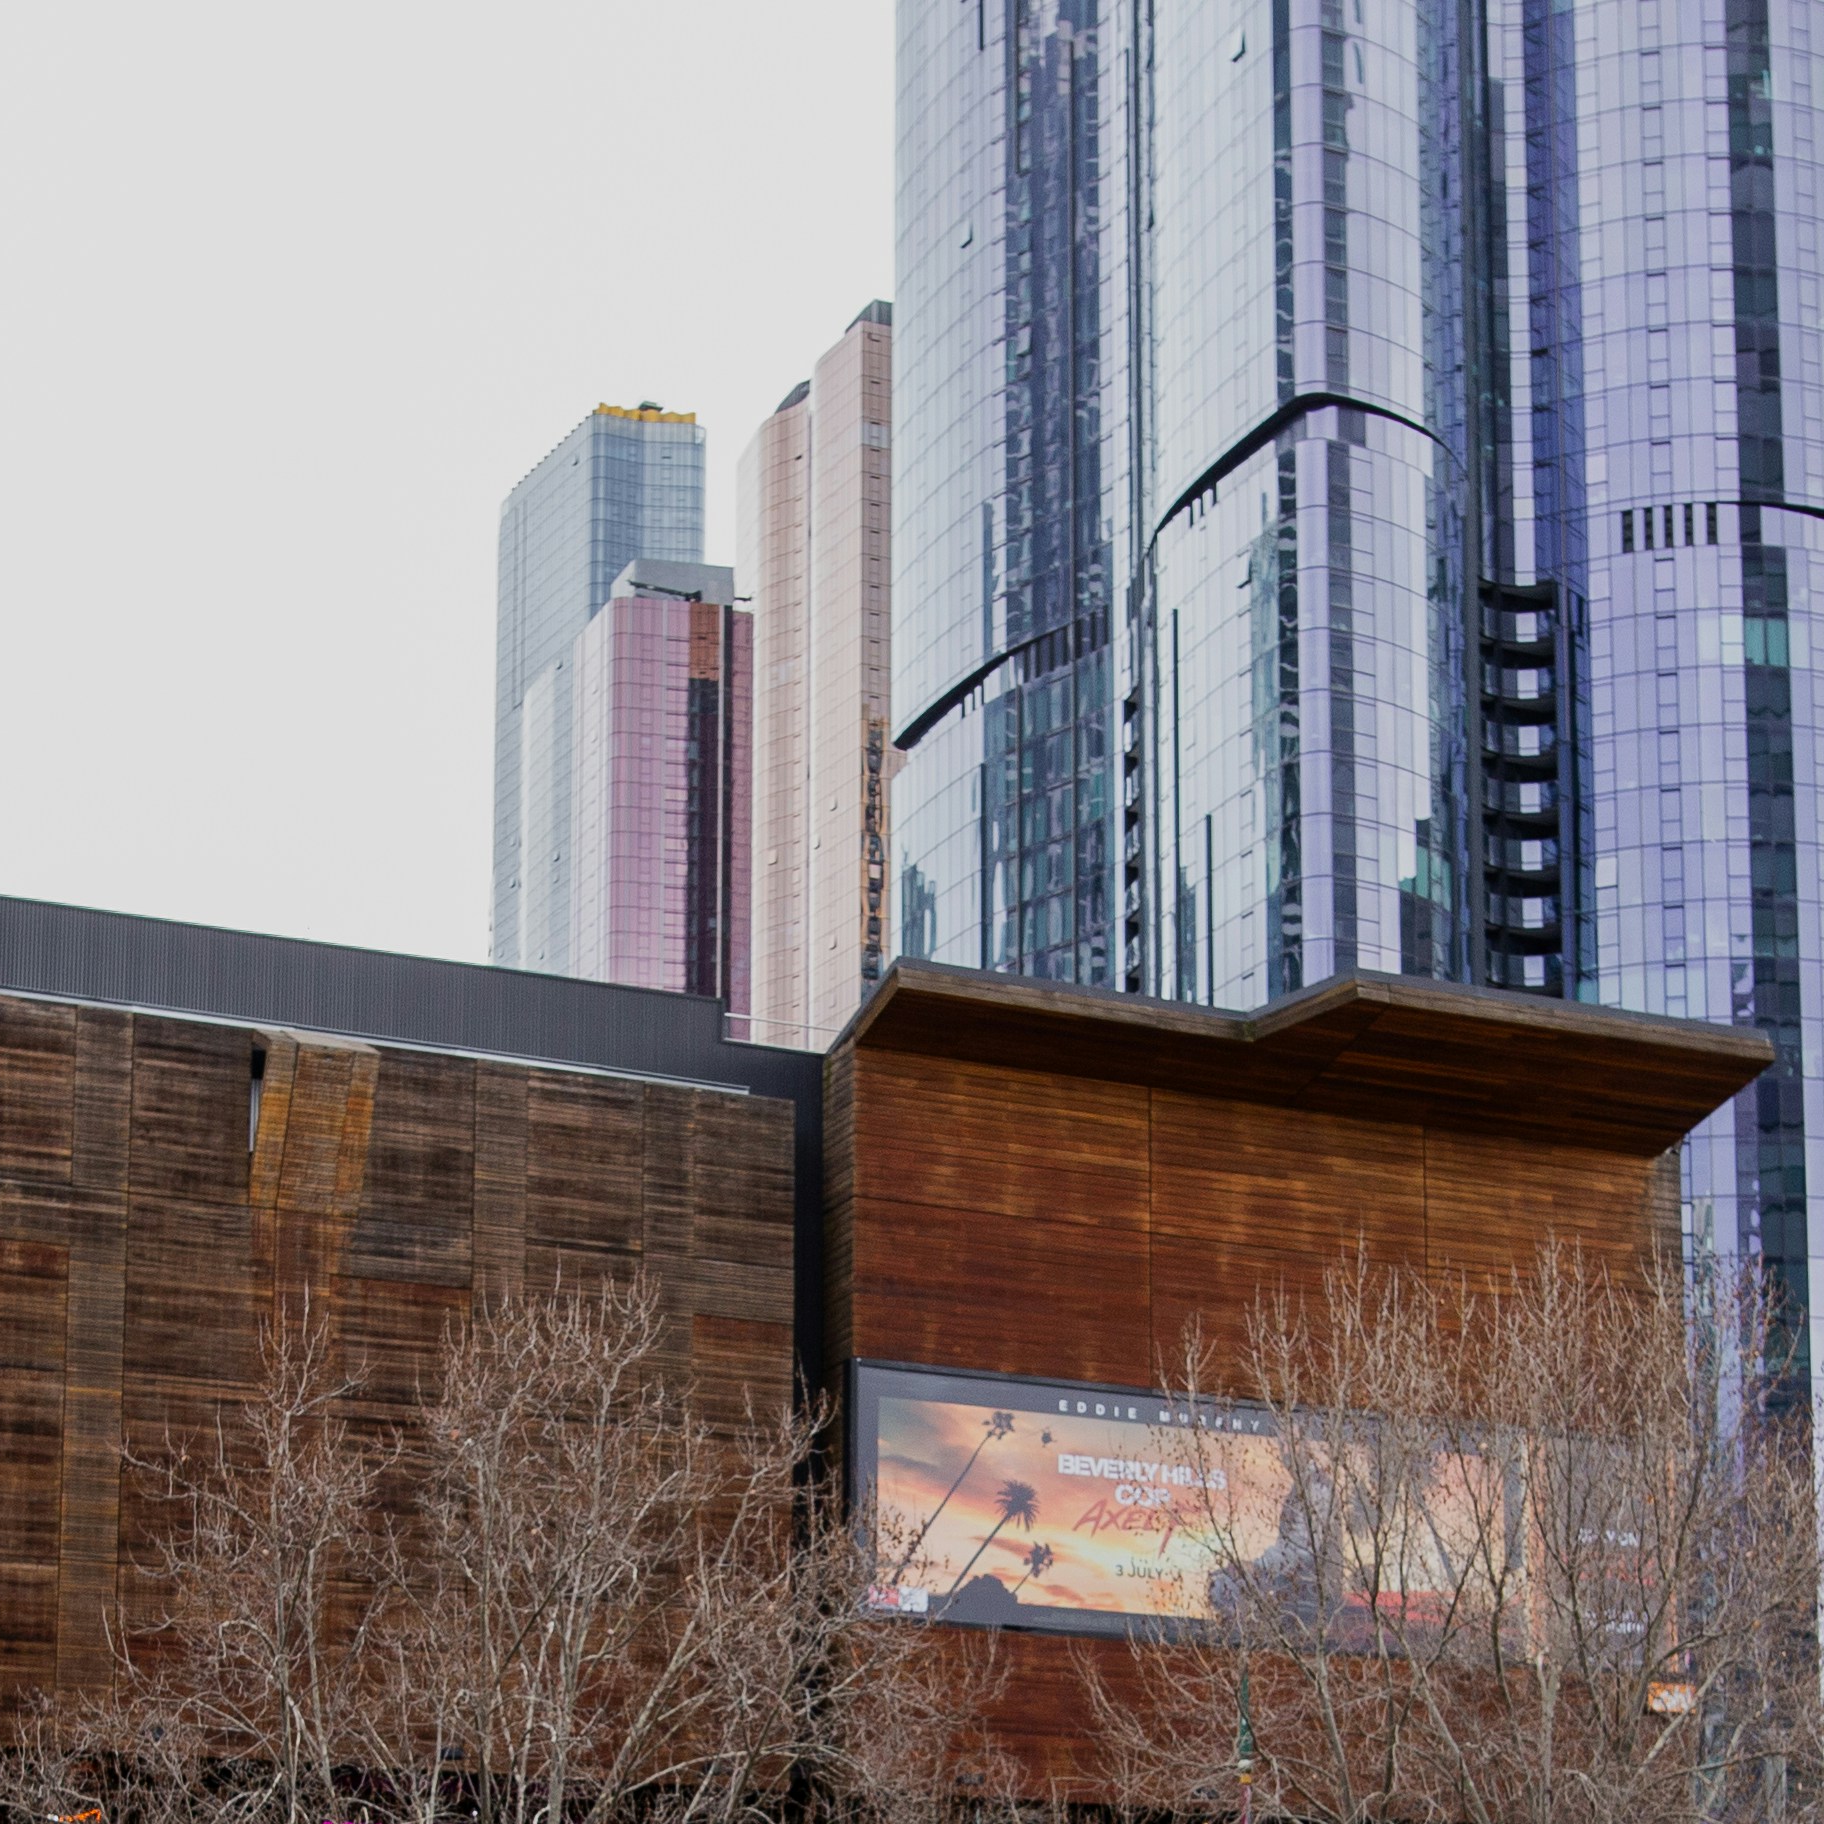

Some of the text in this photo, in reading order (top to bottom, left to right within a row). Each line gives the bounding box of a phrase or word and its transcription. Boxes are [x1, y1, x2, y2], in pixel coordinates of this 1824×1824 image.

[1058, 1400, 1137, 1420] EDDIE
[1058, 1454, 1158, 1484] BEVERLY
[1114, 1484, 1172, 1508] COP
[1115, 1562, 1164, 1579] 3 JULY
